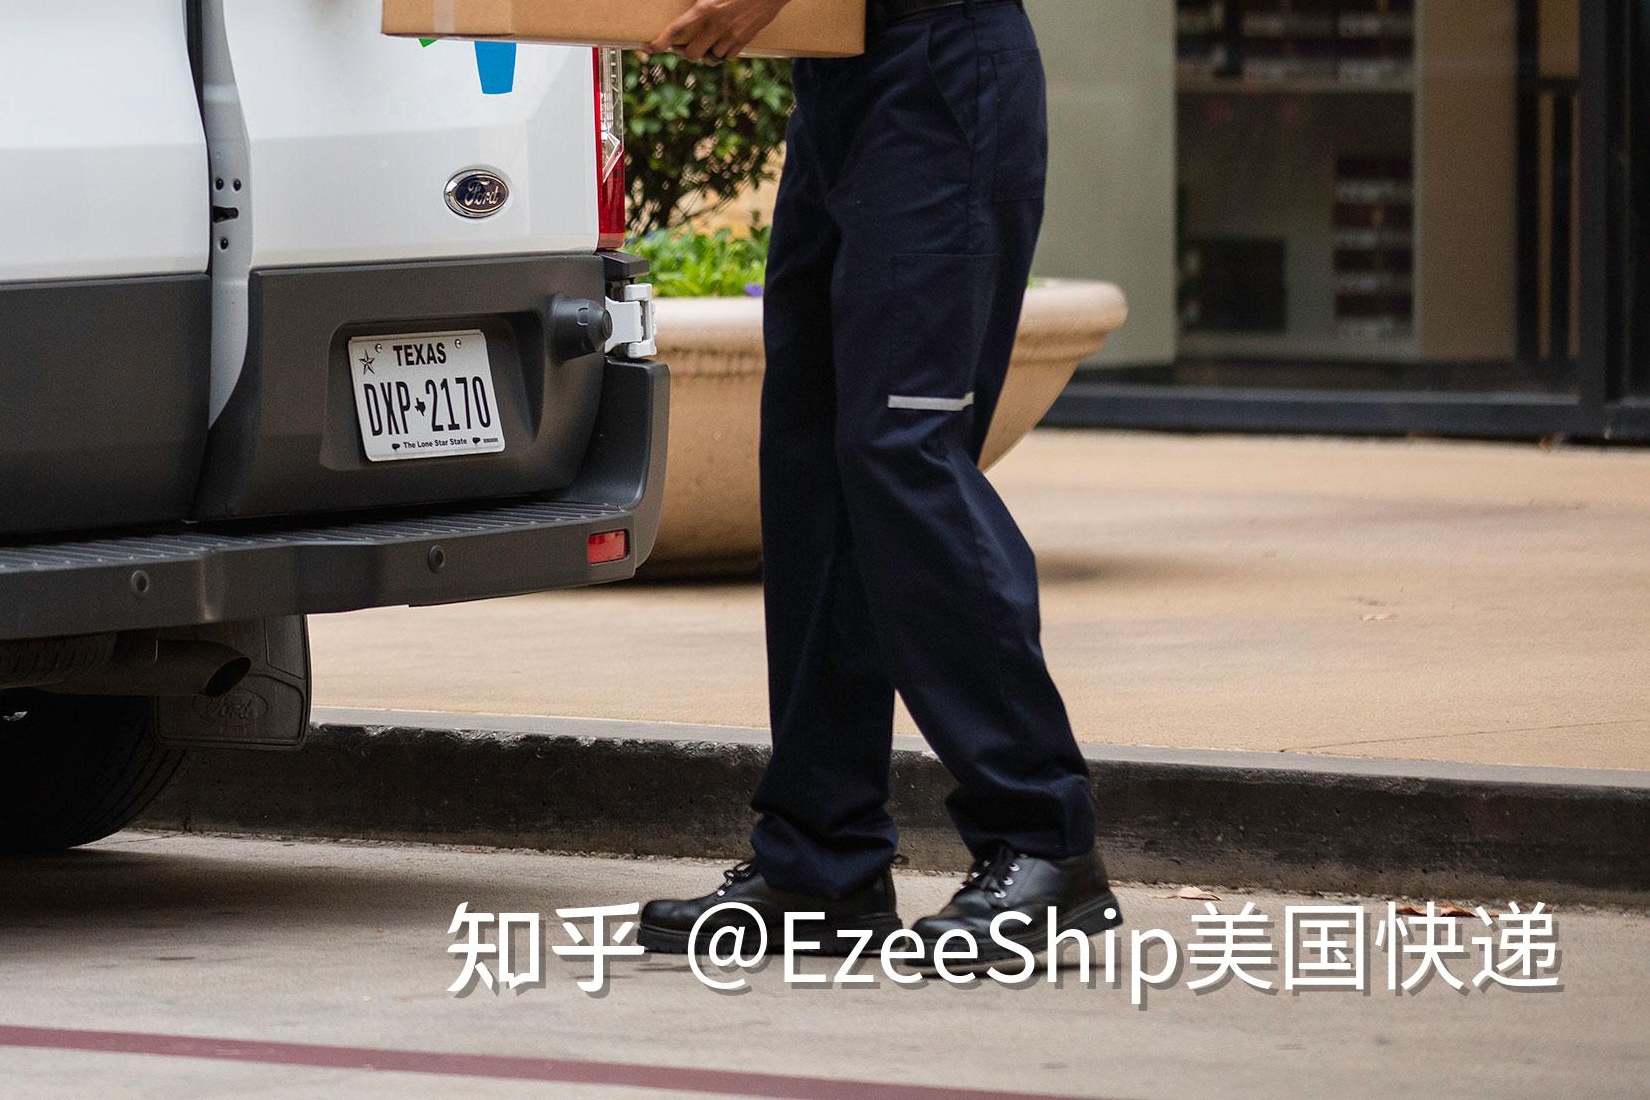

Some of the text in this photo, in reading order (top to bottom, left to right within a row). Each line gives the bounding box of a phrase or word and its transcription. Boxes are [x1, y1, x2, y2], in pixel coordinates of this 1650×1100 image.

[464, 179, 499, 206] Ford
[393, 342, 447, 366] TEXAS
[403, 441, 416, 449] The
[417, 440, 433, 448] Lone
[450, 437, 468, 445] State
